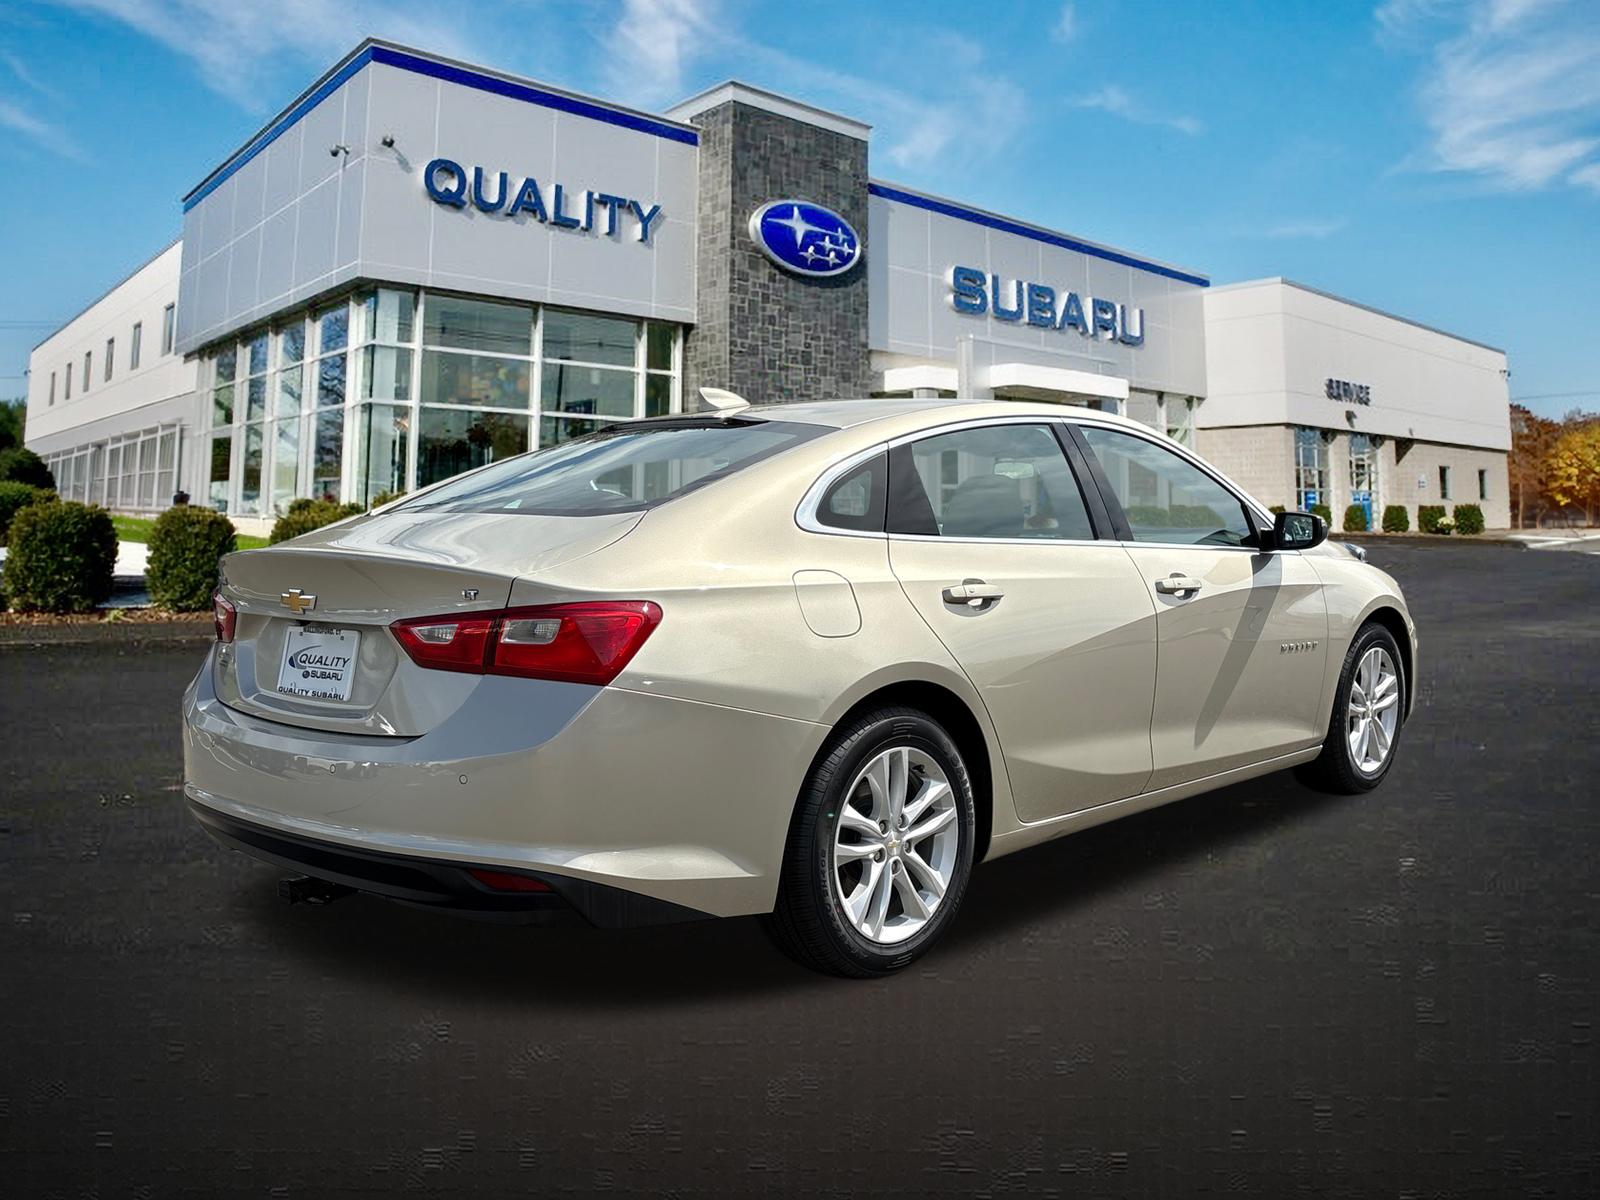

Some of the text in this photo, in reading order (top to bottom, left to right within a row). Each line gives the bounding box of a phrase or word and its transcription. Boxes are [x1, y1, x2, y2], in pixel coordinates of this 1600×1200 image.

[424, 158, 661, 242] QUALITY
[949, 265, 1145, 346] SUBARU
[1325, 378, 1371, 406] SERVICE
[462, 589, 479, 600] LT
[299, 653, 350, 668] QUALITY
[310, 670, 343, 681] SUBARU
[278, 686, 344, 701] QUALITY SUBARU
